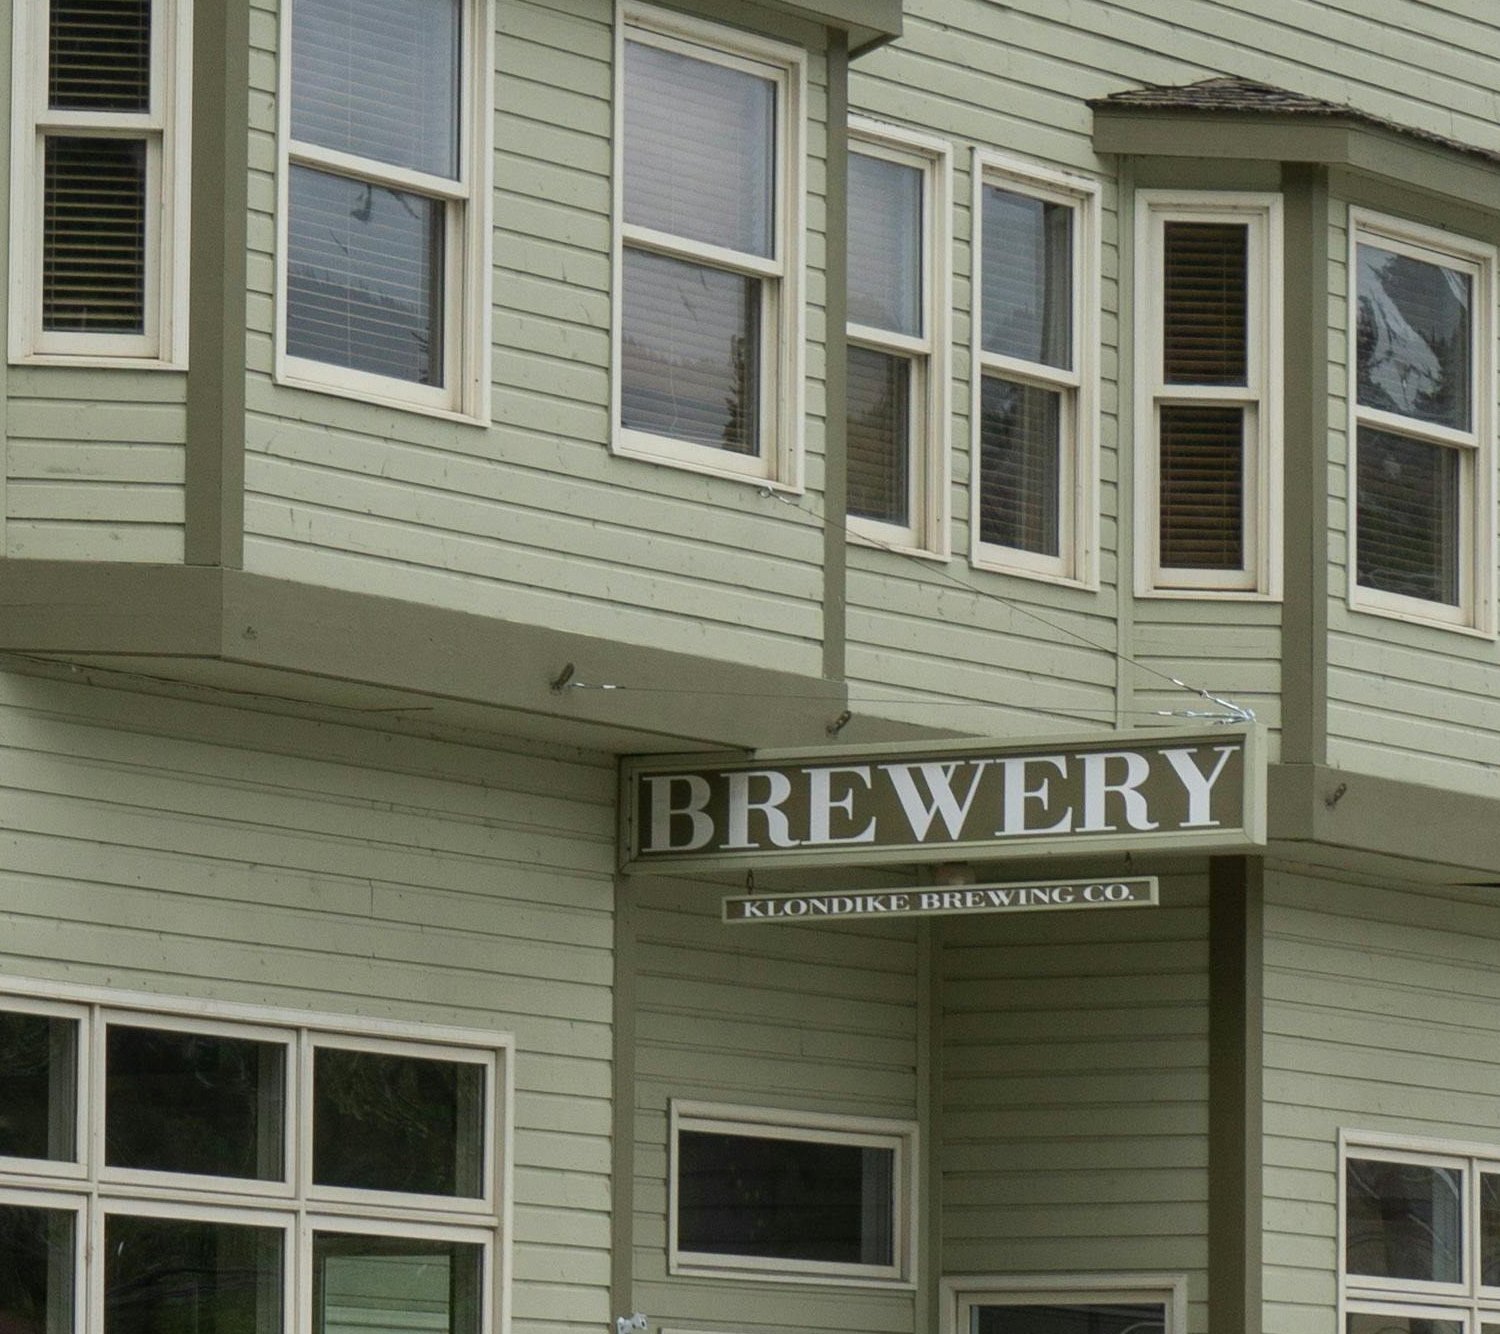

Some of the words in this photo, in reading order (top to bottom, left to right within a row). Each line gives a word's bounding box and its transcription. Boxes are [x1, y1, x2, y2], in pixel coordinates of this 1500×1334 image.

[641, 746, 1240, 853] BREWERY
[743, 895, 910, 918] KLONDIKE
[920, 886, 1075, 910] BREWING
[1083, 884, 1135, 902] CO.
